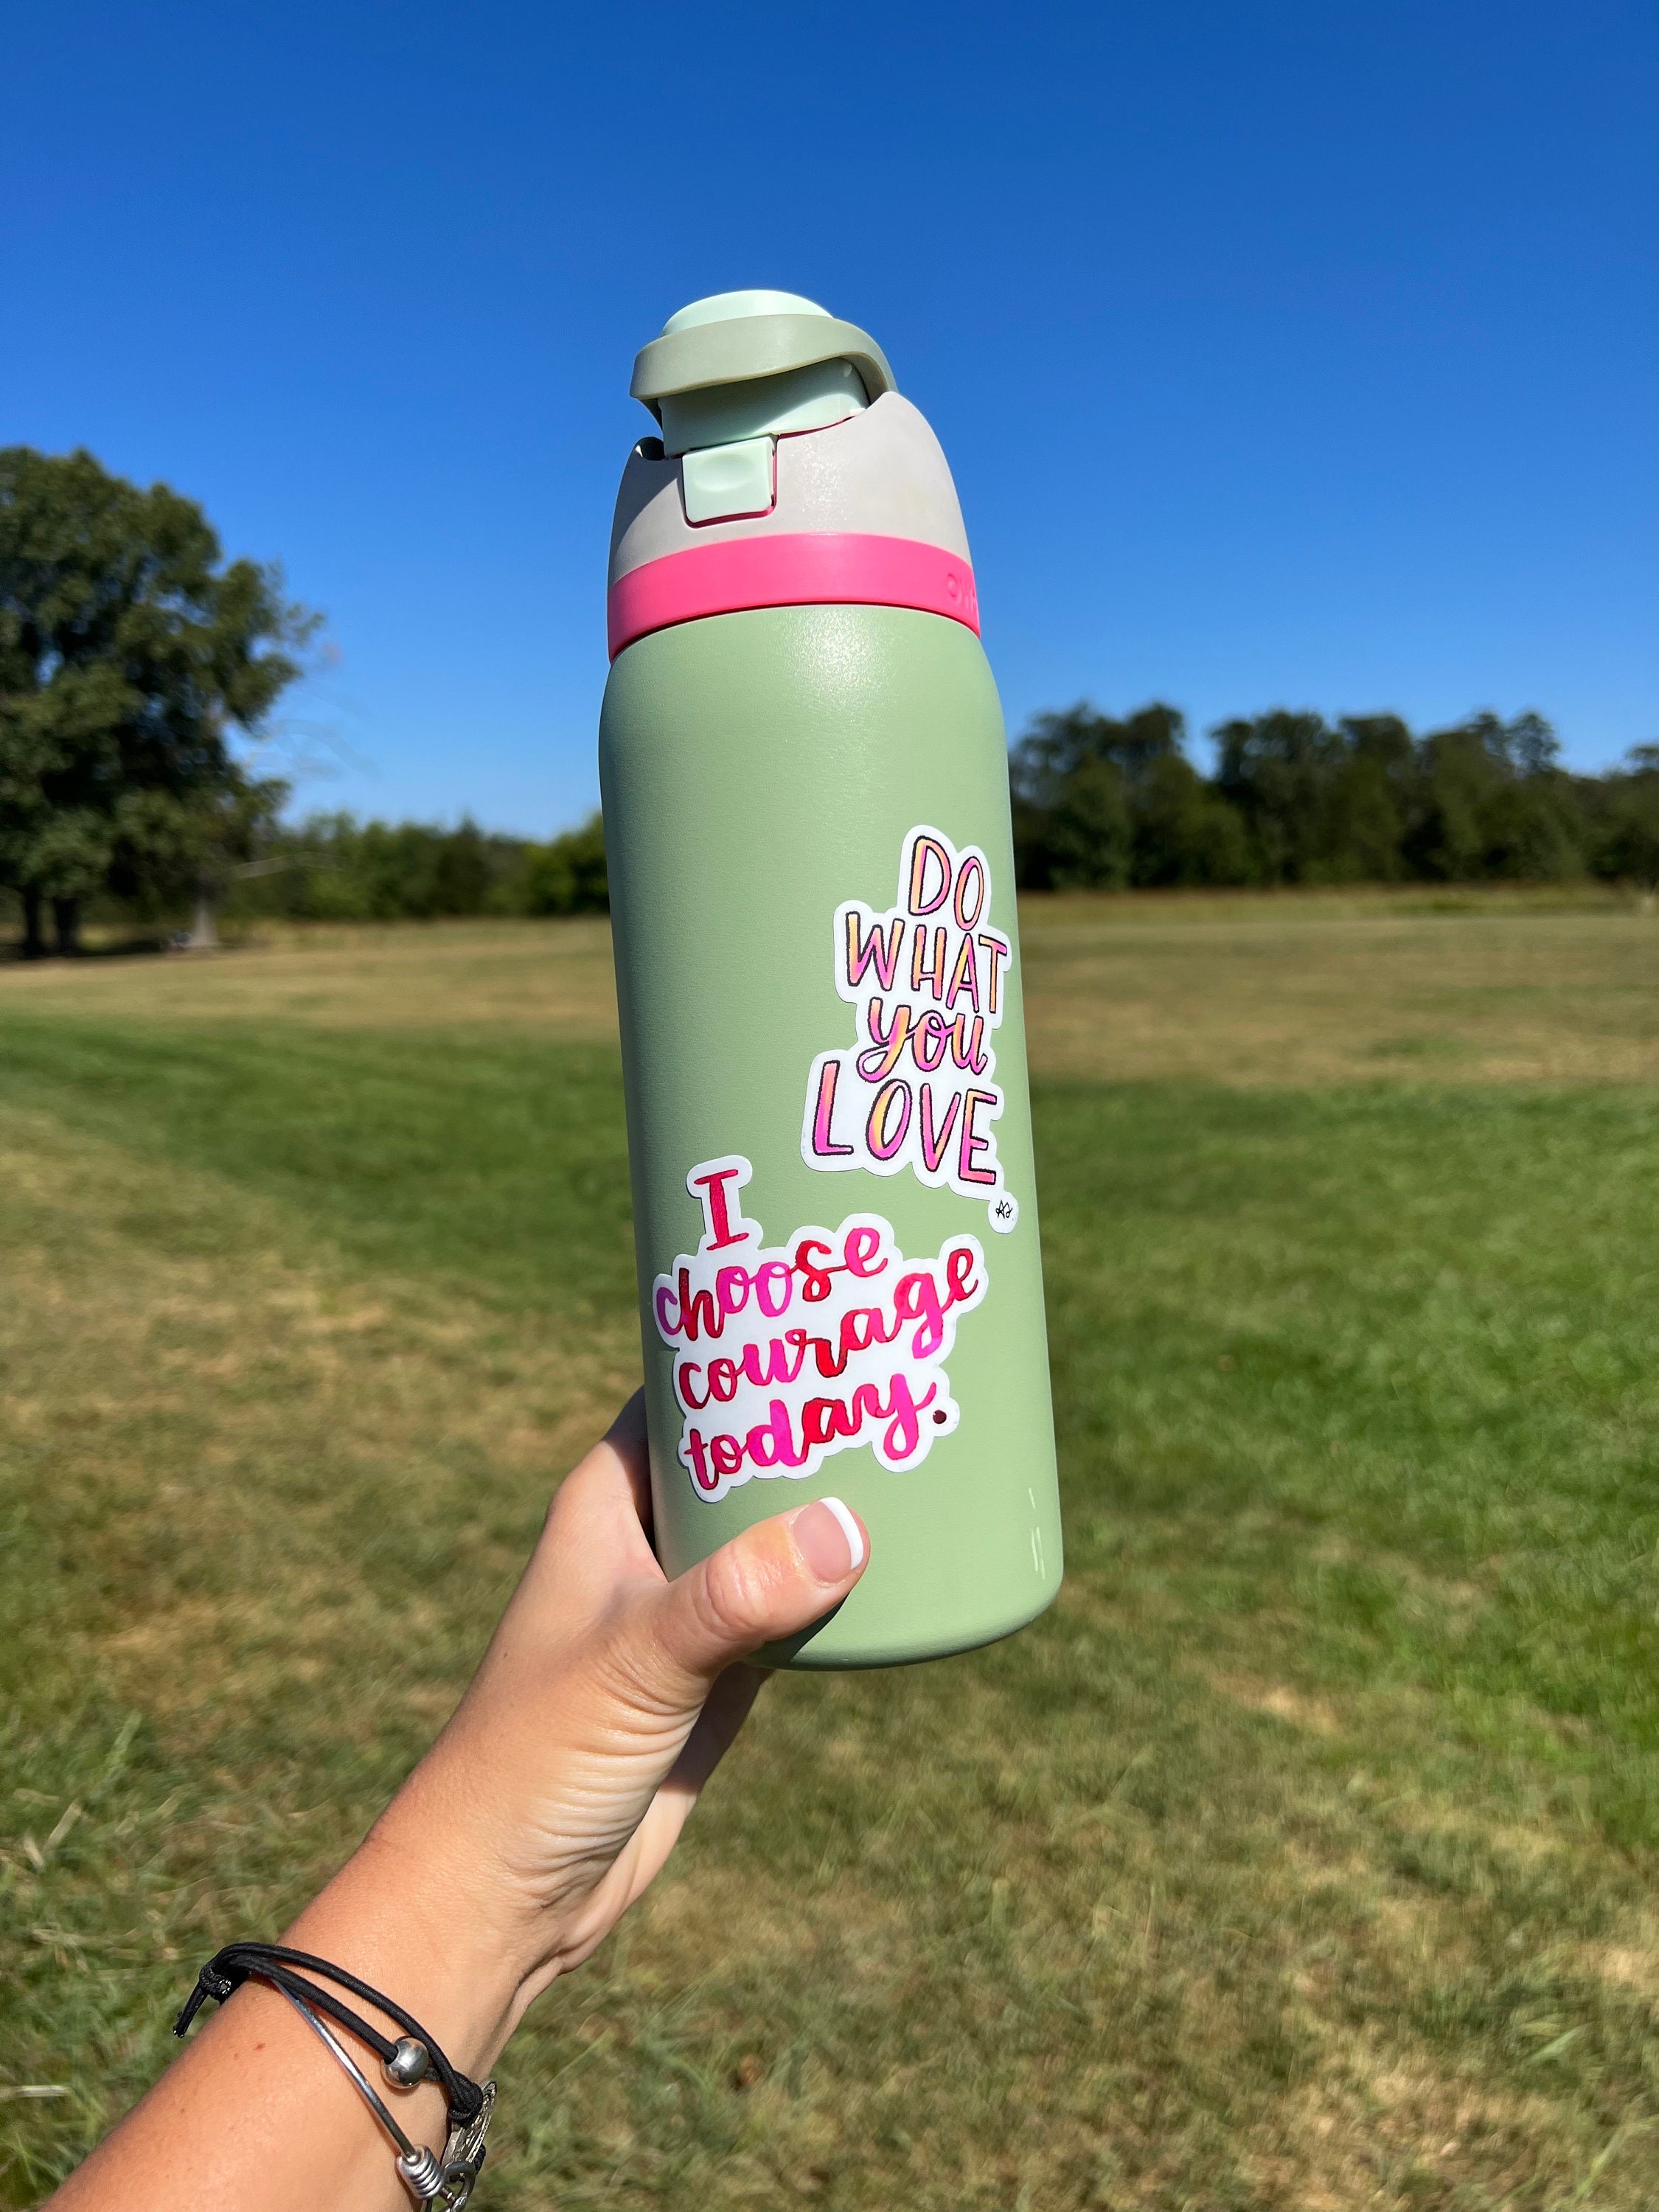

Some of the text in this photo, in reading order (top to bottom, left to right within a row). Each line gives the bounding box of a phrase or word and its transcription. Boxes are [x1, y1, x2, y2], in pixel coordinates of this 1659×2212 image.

[908, 835, 984, 931] DO
[846, 911, 1007, 1013] WHAT
[856, 997, 988, 1083] you
[812, 1060, 997, 1185] LOVE
[694, 1169, 749, 1251] I
[656, 1227, 888, 1341] choose
[679, 1248, 978, 1410] courage
[684, 1373, 947, 1490] today.
